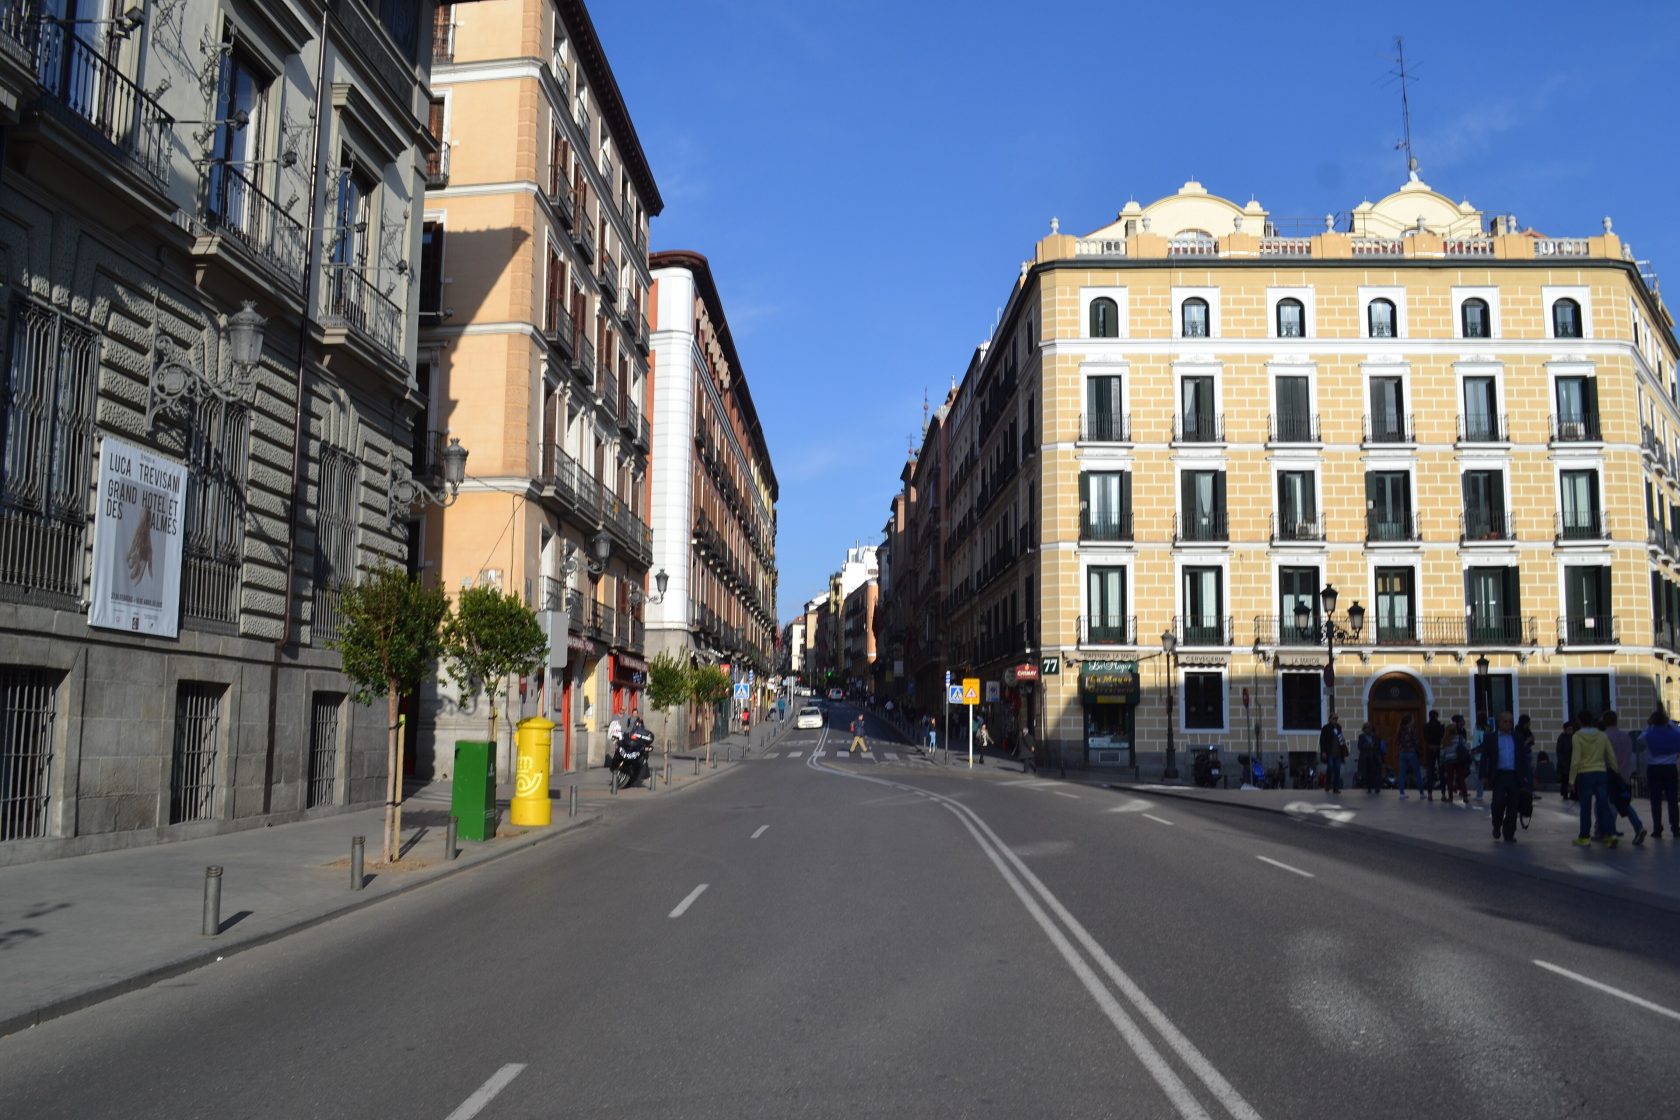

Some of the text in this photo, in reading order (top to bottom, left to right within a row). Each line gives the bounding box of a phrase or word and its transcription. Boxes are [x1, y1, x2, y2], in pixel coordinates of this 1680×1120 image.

[109, 453, 131, 476] LUCA
[139, 463, 180, 493] TREVISANI
[107, 479, 178, 517] GRAND HOTEL ET
[106, 499, 177, 536] DES PALMES
[1043, 659, 1058, 673] 77
